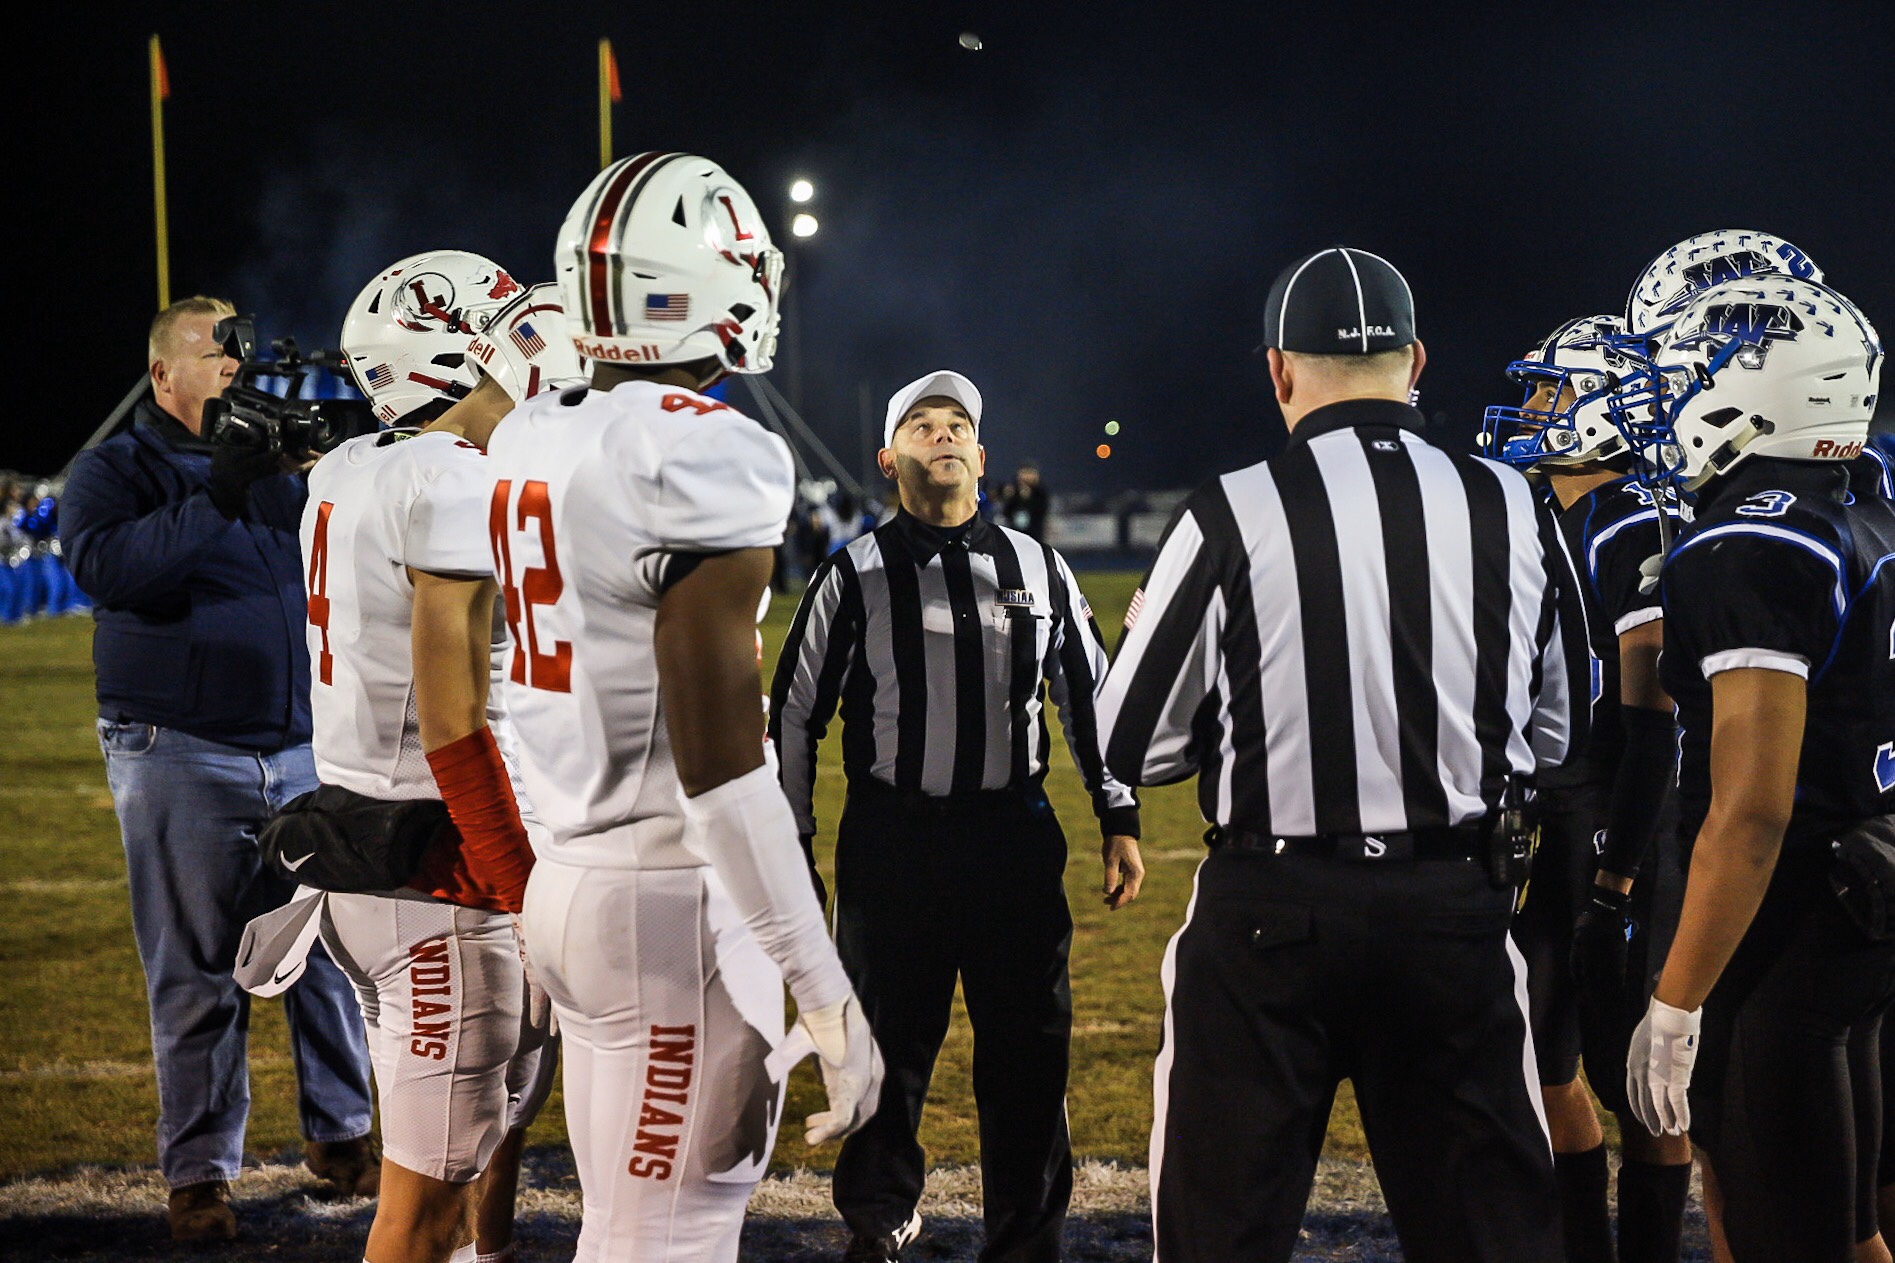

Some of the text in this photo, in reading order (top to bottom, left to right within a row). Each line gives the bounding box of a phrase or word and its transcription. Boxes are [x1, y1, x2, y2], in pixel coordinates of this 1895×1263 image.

[717, 195, 755, 242] L
[408, 279, 446, 315] L
[572, 337, 662, 362] Riddell
[1735, 489, 1797, 518] 3
[307, 500, 335, 686] 4
[488, 478, 573, 694] 42
[627, 1023, 696, 1181] INDIANS
